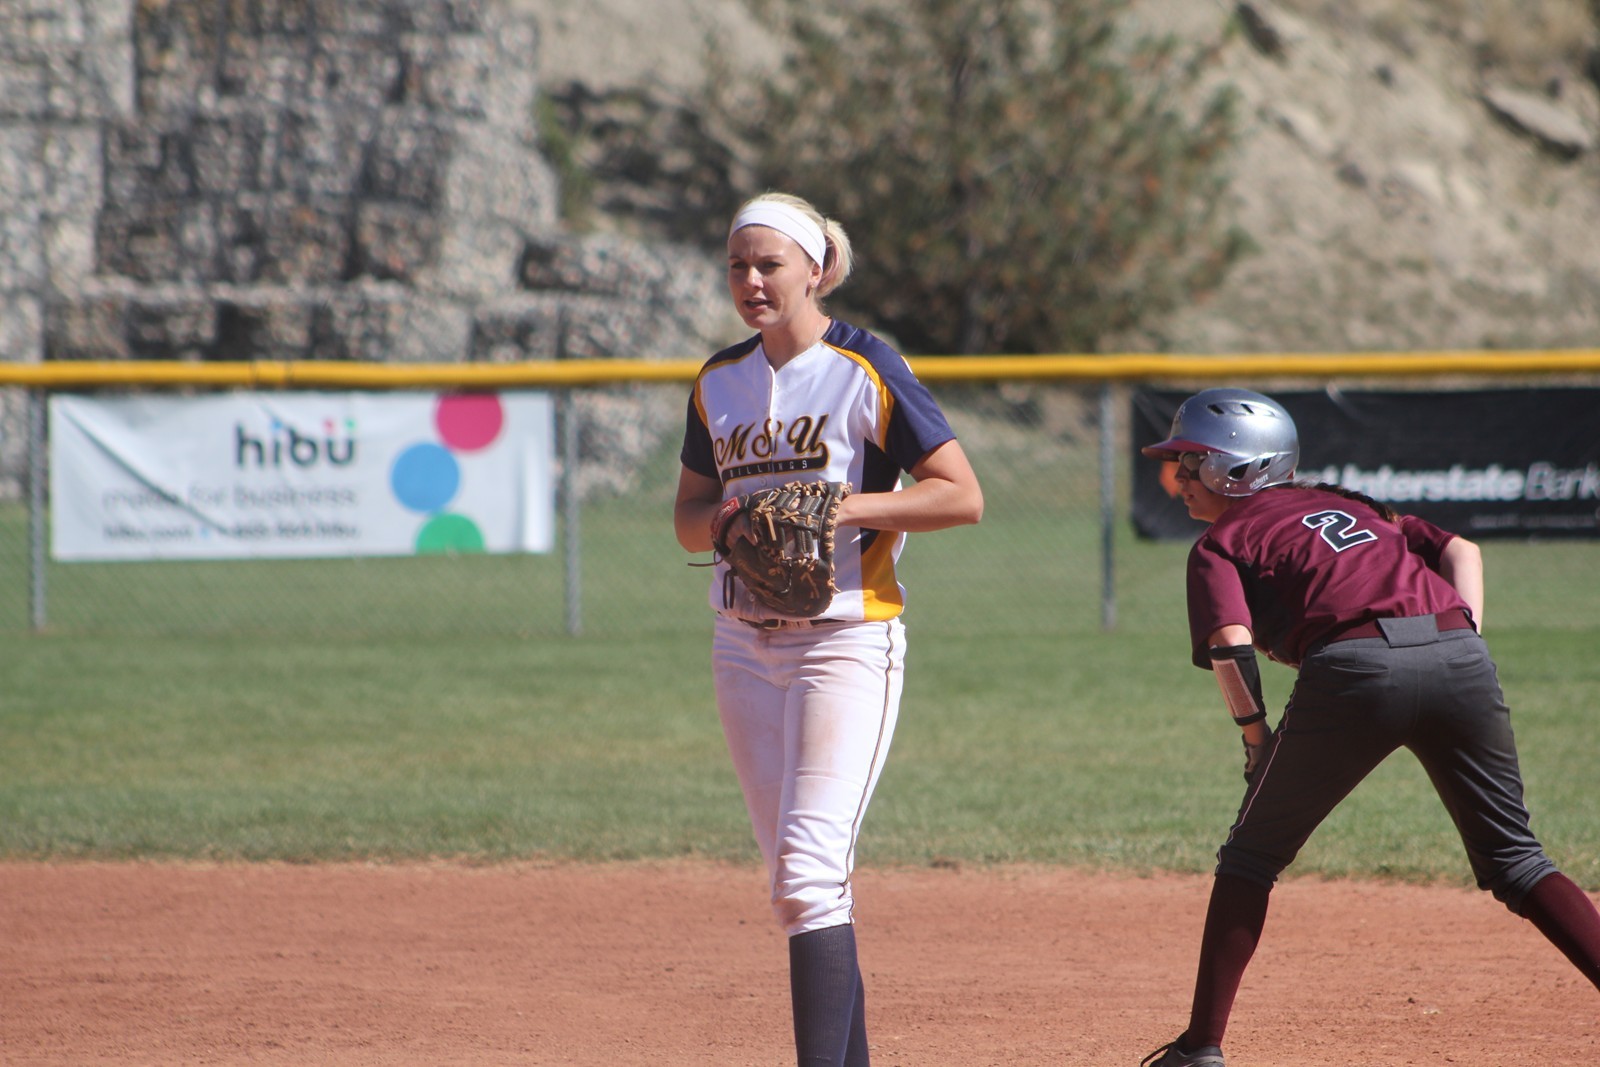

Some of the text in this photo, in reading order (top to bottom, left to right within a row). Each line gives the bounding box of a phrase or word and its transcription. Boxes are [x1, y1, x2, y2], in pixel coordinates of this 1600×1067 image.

[729, 459, 808, 479] BILLINGS
[1341, 463, 1525, 502] Interstate
[1301, 509, 1379, 553] 2
